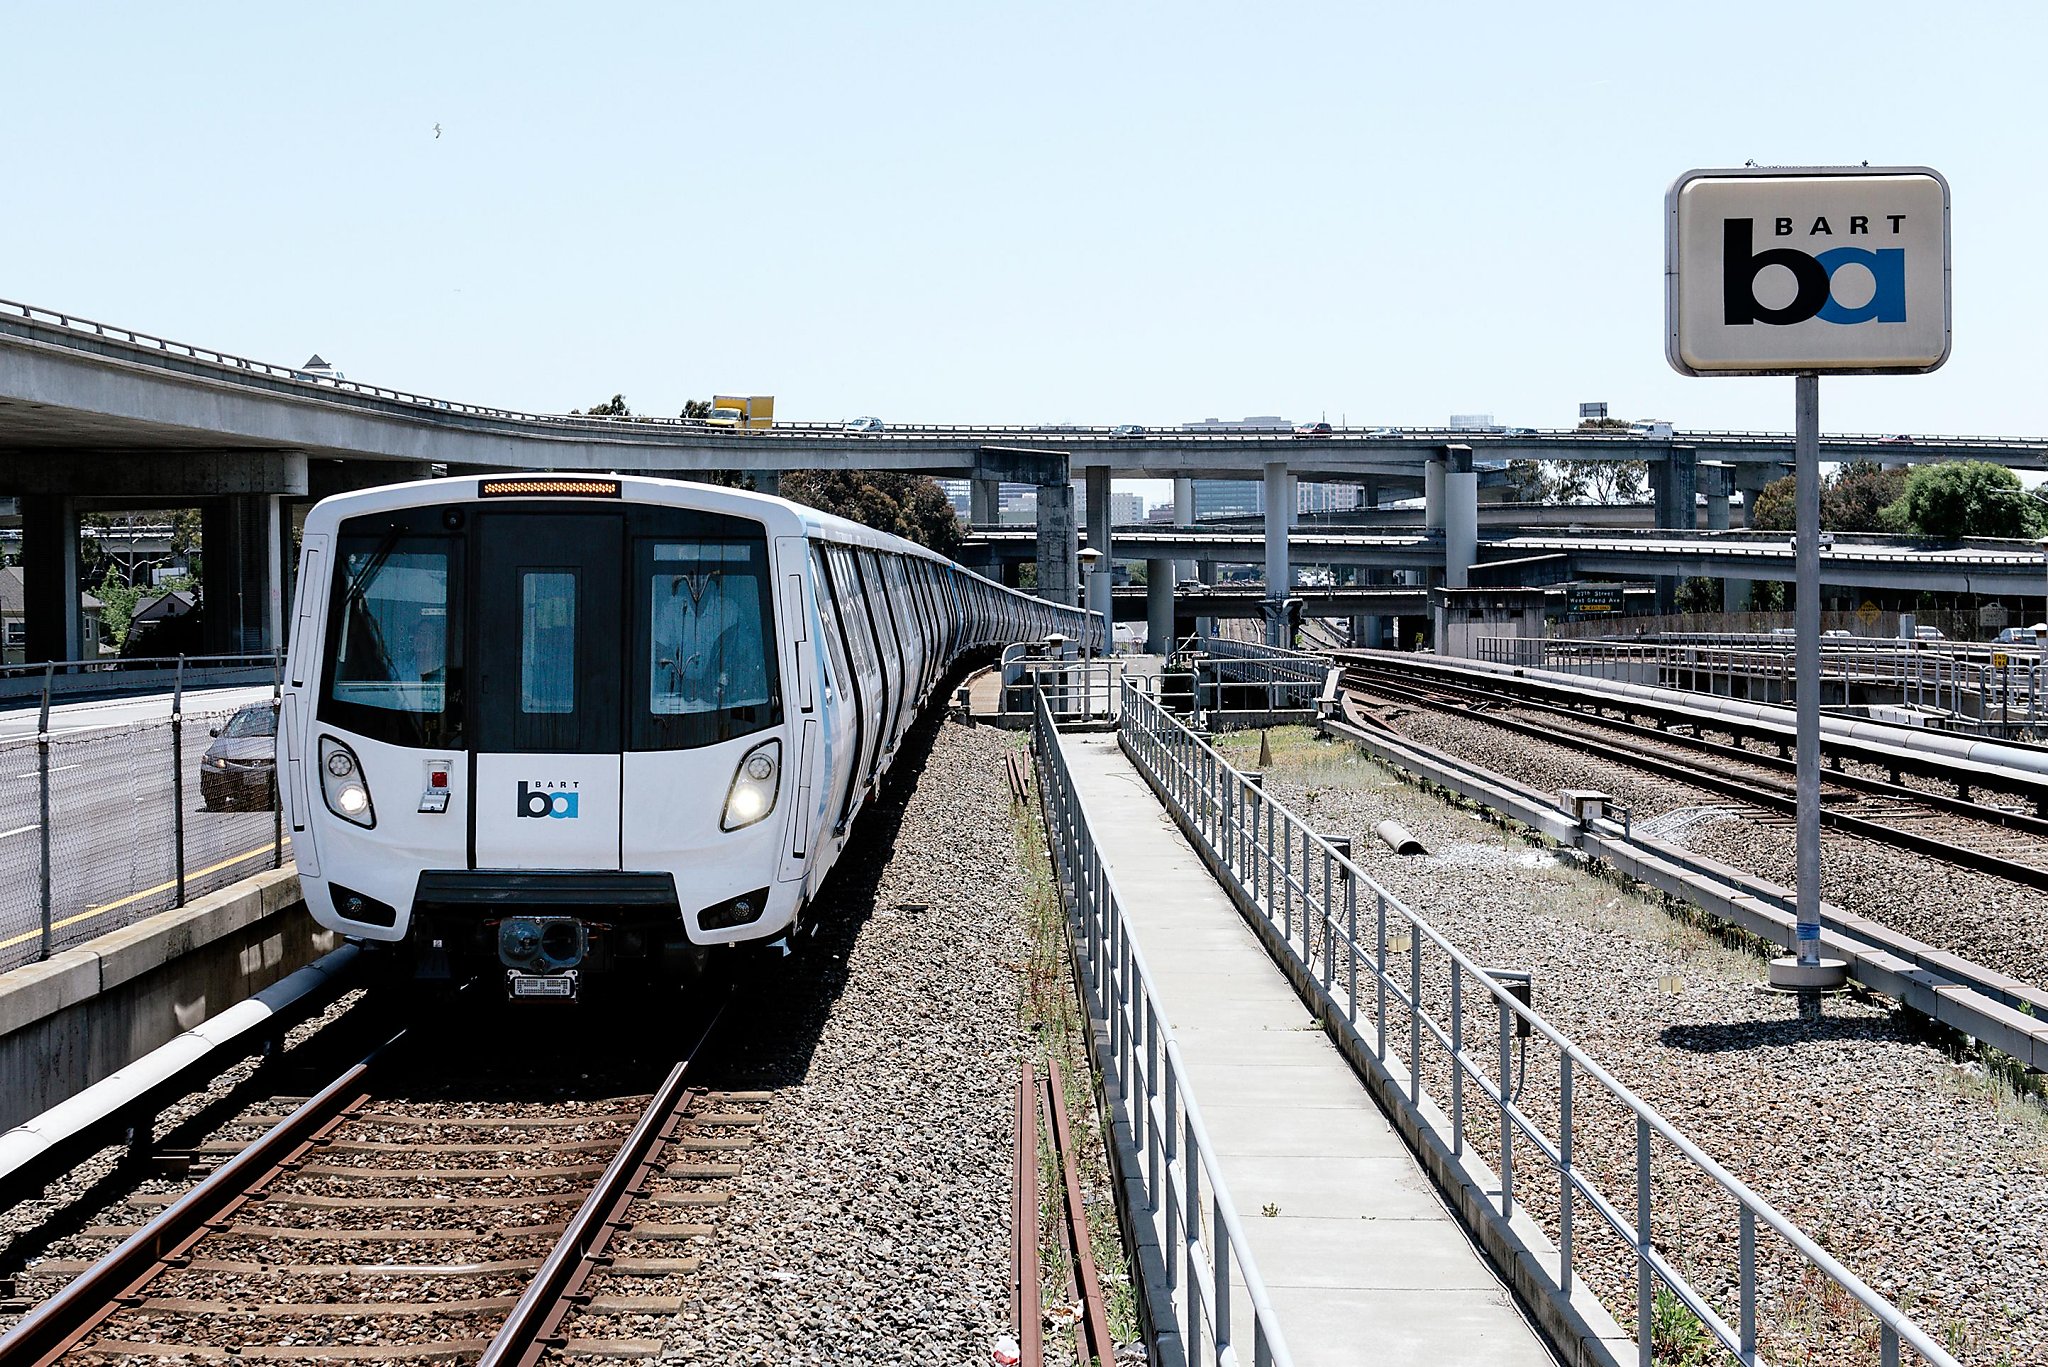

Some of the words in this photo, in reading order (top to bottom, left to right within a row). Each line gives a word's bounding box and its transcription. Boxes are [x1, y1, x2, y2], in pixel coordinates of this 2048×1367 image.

[1775, 214, 1906, 236] BART
[1723, 217, 1907, 326] ba
[517, 780, 579, 819] ba
